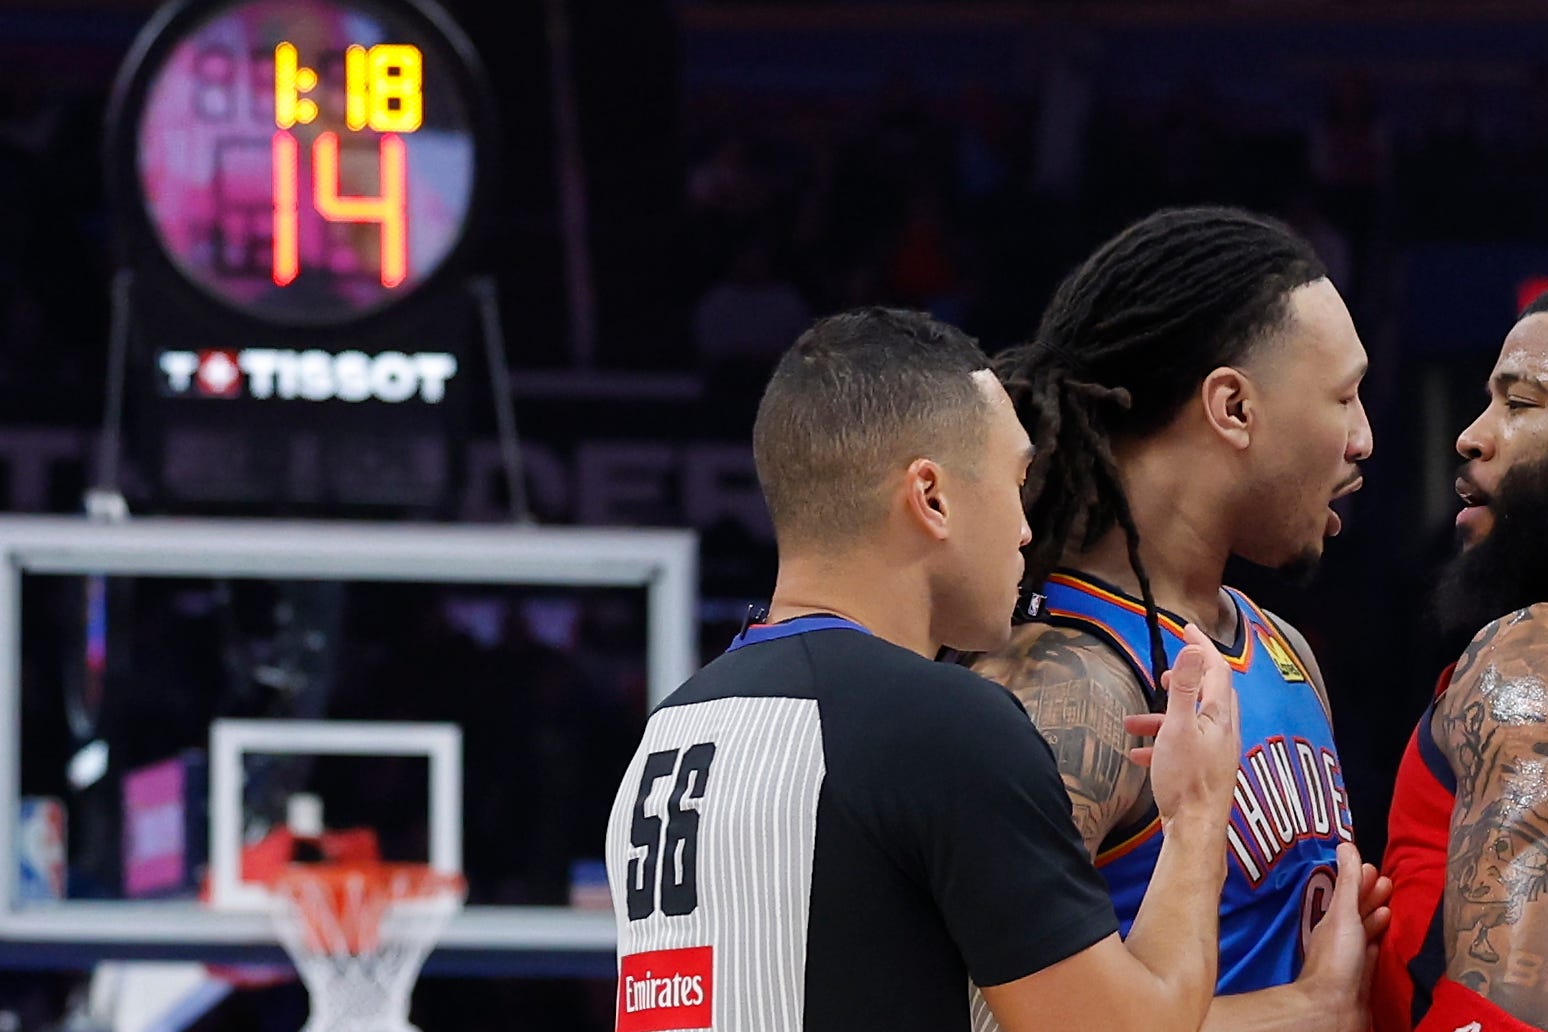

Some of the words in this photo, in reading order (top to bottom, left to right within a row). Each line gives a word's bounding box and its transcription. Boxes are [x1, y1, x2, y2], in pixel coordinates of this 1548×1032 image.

[274, 41, 424, 133] 1:18
[271, 129, 408, 289] 14
[240, 348, 458, 402] TISSOT
[626, 741, 717, 922] 56
[625, 970, 705, 1014] Emirates
